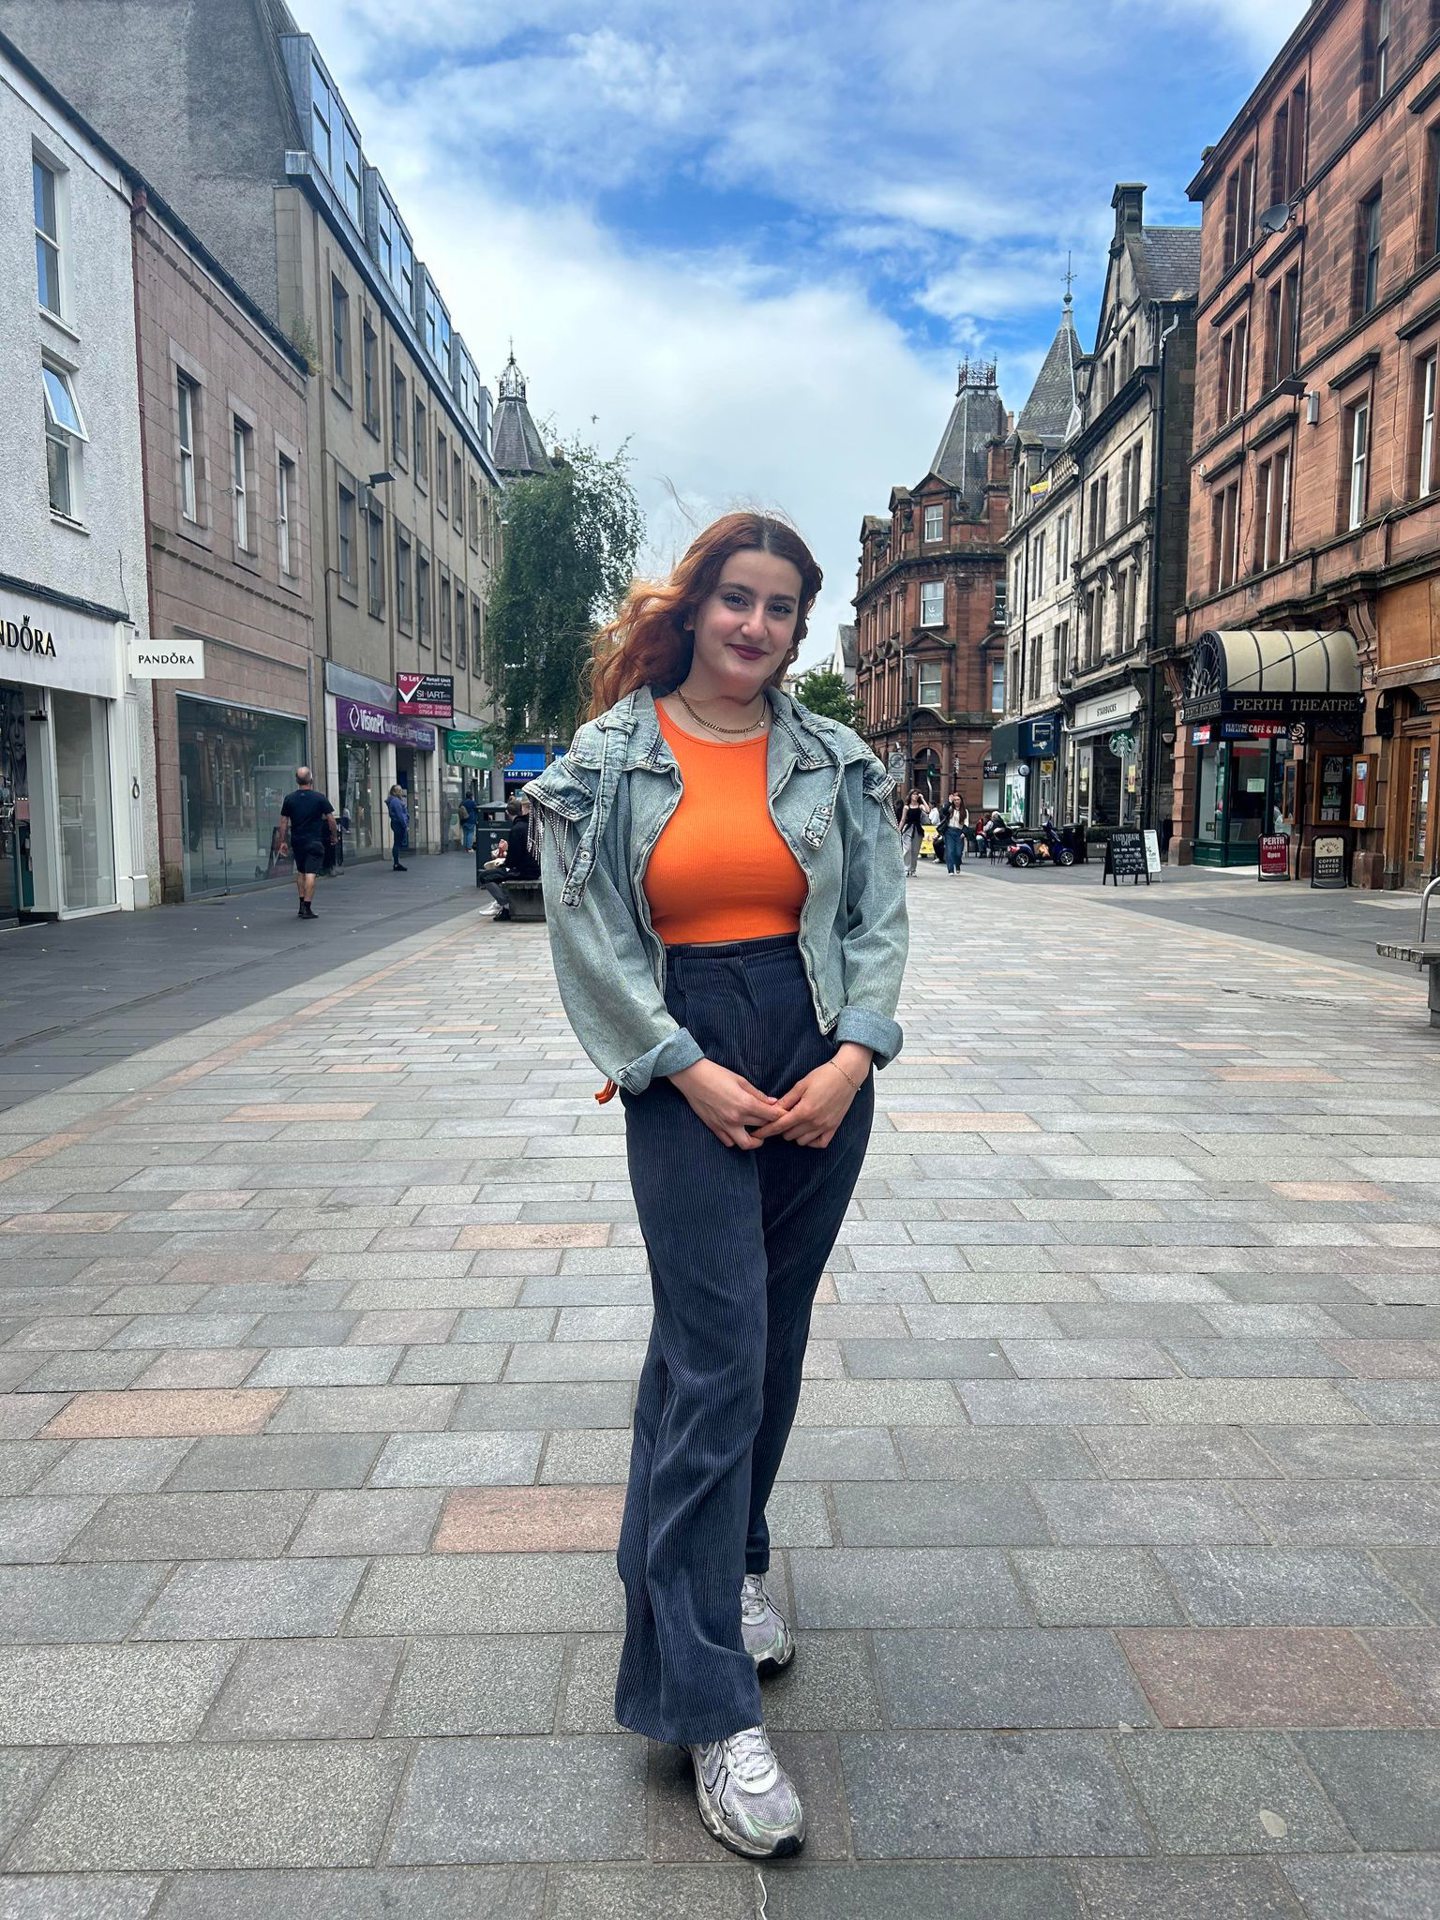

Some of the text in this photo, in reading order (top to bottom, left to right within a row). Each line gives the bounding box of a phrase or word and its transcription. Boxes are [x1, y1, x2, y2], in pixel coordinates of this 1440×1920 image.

[138, 653, 195, 665] PANDORA
[1232, 698, 1283, 712] PERTH
[1290, 698, 1358, 712] THEATRE
[1272, 726, 1287, 735] BAR
[1263, 837, 1285, 845] PERTH
